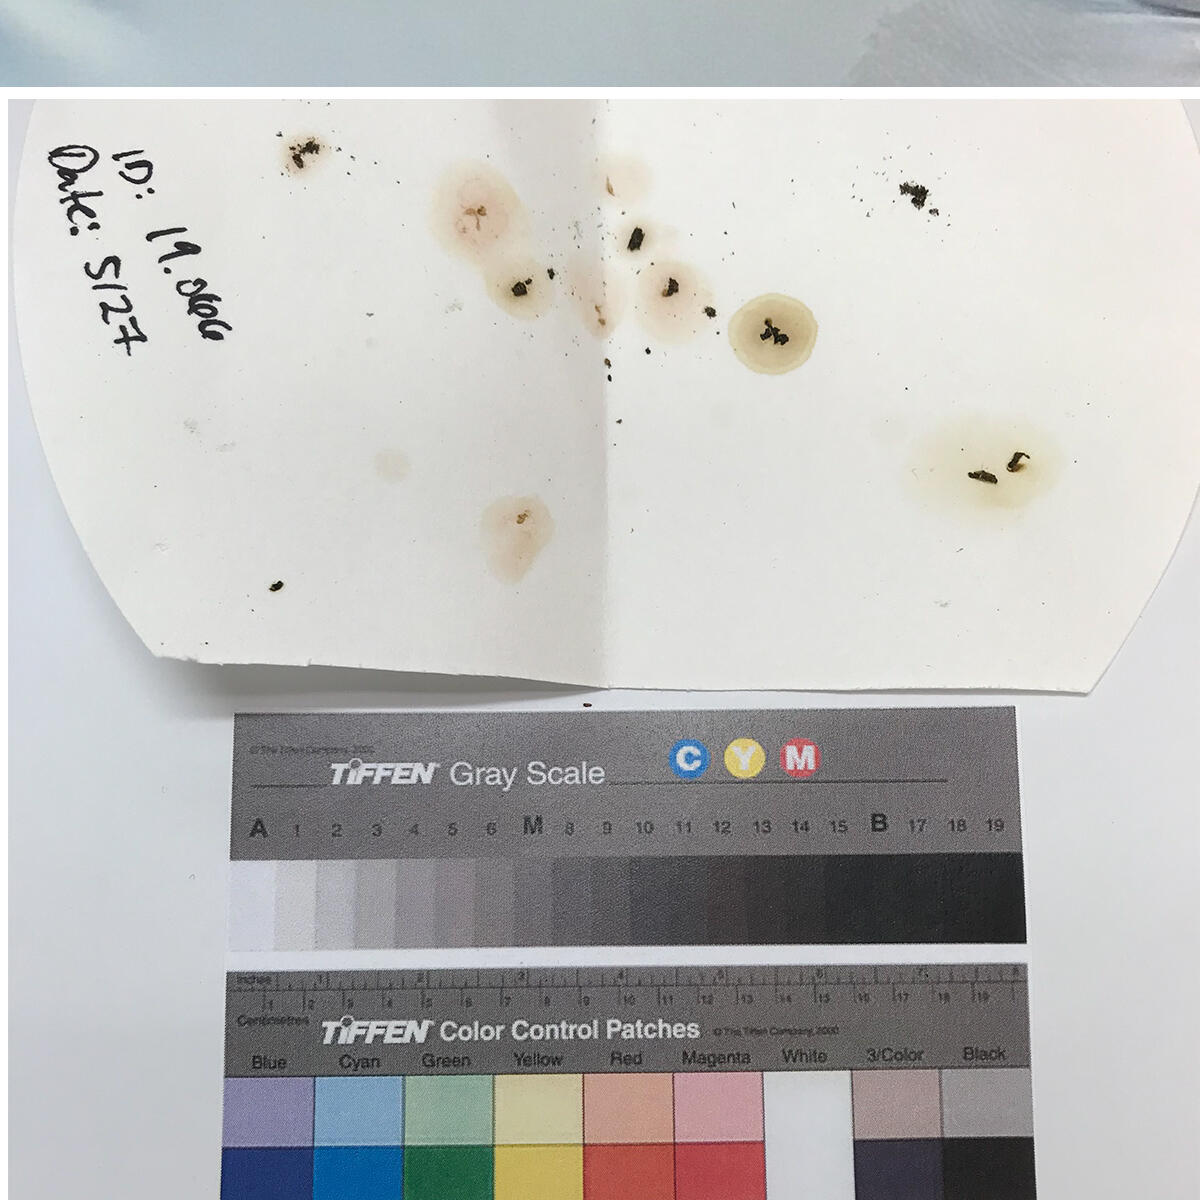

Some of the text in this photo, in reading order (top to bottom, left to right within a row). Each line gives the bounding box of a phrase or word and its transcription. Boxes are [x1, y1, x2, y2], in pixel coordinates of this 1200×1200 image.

[111, 149, 155, 199] ID:
[47, 144, 104, 237] Date:
[675, 744, 816, 772] C Y M
[450, 761, 518, 792] Gray
[526, 760, 606, 786] Scale
[248, 817, 269, 839] A
[331, 823, 343, 838] 2
[371, 823, 383, 837] 3
[409, 822, 420, 837] 4
[447, 822, 458, 836] 5
[486, 821, 497, 836] 6
[522, 814, 544, 836] M
[565, 821, 575, 836] 8
[603, 820, 613, 834] 9
[636, 820, 654, 834] 10
[676, 820, 692, 834] 11
[713, 820, 731, 834] 12
[753, 819, 772, 833] 13
[792, 819, 810, 833] 14
[830, 819, 848, 833] 15
[870, 812, 890, 833] B
[908, 818, 928, 833] 17
[948, 817, 967, 832] 18
[985, 818, 1005, 832] 19
[439, 1019, 506, 1042] Color
[511, 1018, 600, 1041] Control
[606, 1017, 701, 1040] Patches
[251, 1045, 1007, 1072] Blue Cyan Green Yellow Red Magenta White 3/Color Black
